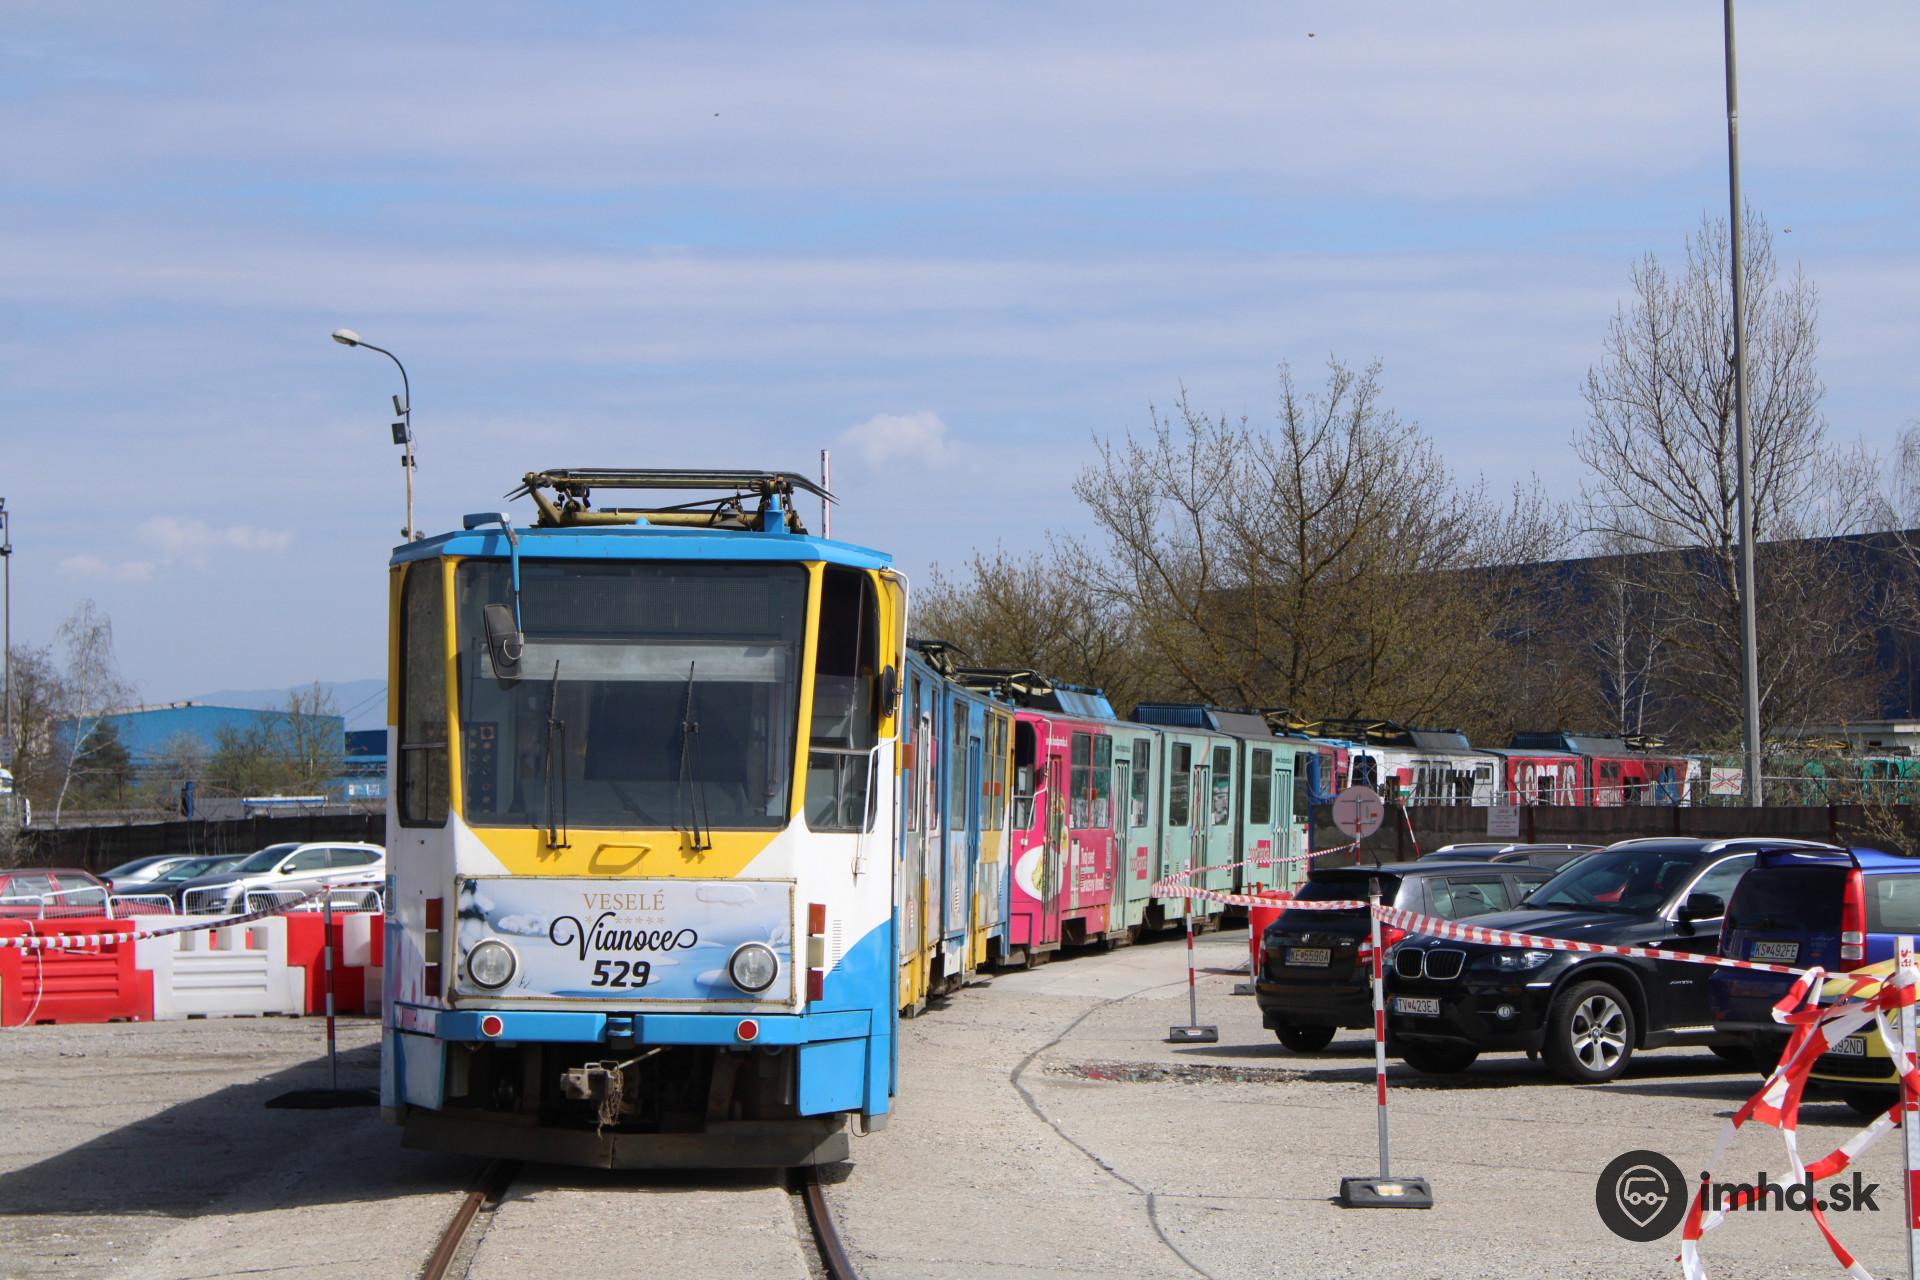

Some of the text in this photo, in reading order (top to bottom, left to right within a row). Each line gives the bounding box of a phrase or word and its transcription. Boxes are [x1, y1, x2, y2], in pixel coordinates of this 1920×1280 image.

[583, 888, 666, 911] VESELÉ
[549, 911, 699, 961] Vianoce
[591, 959, 651, 988] 529
